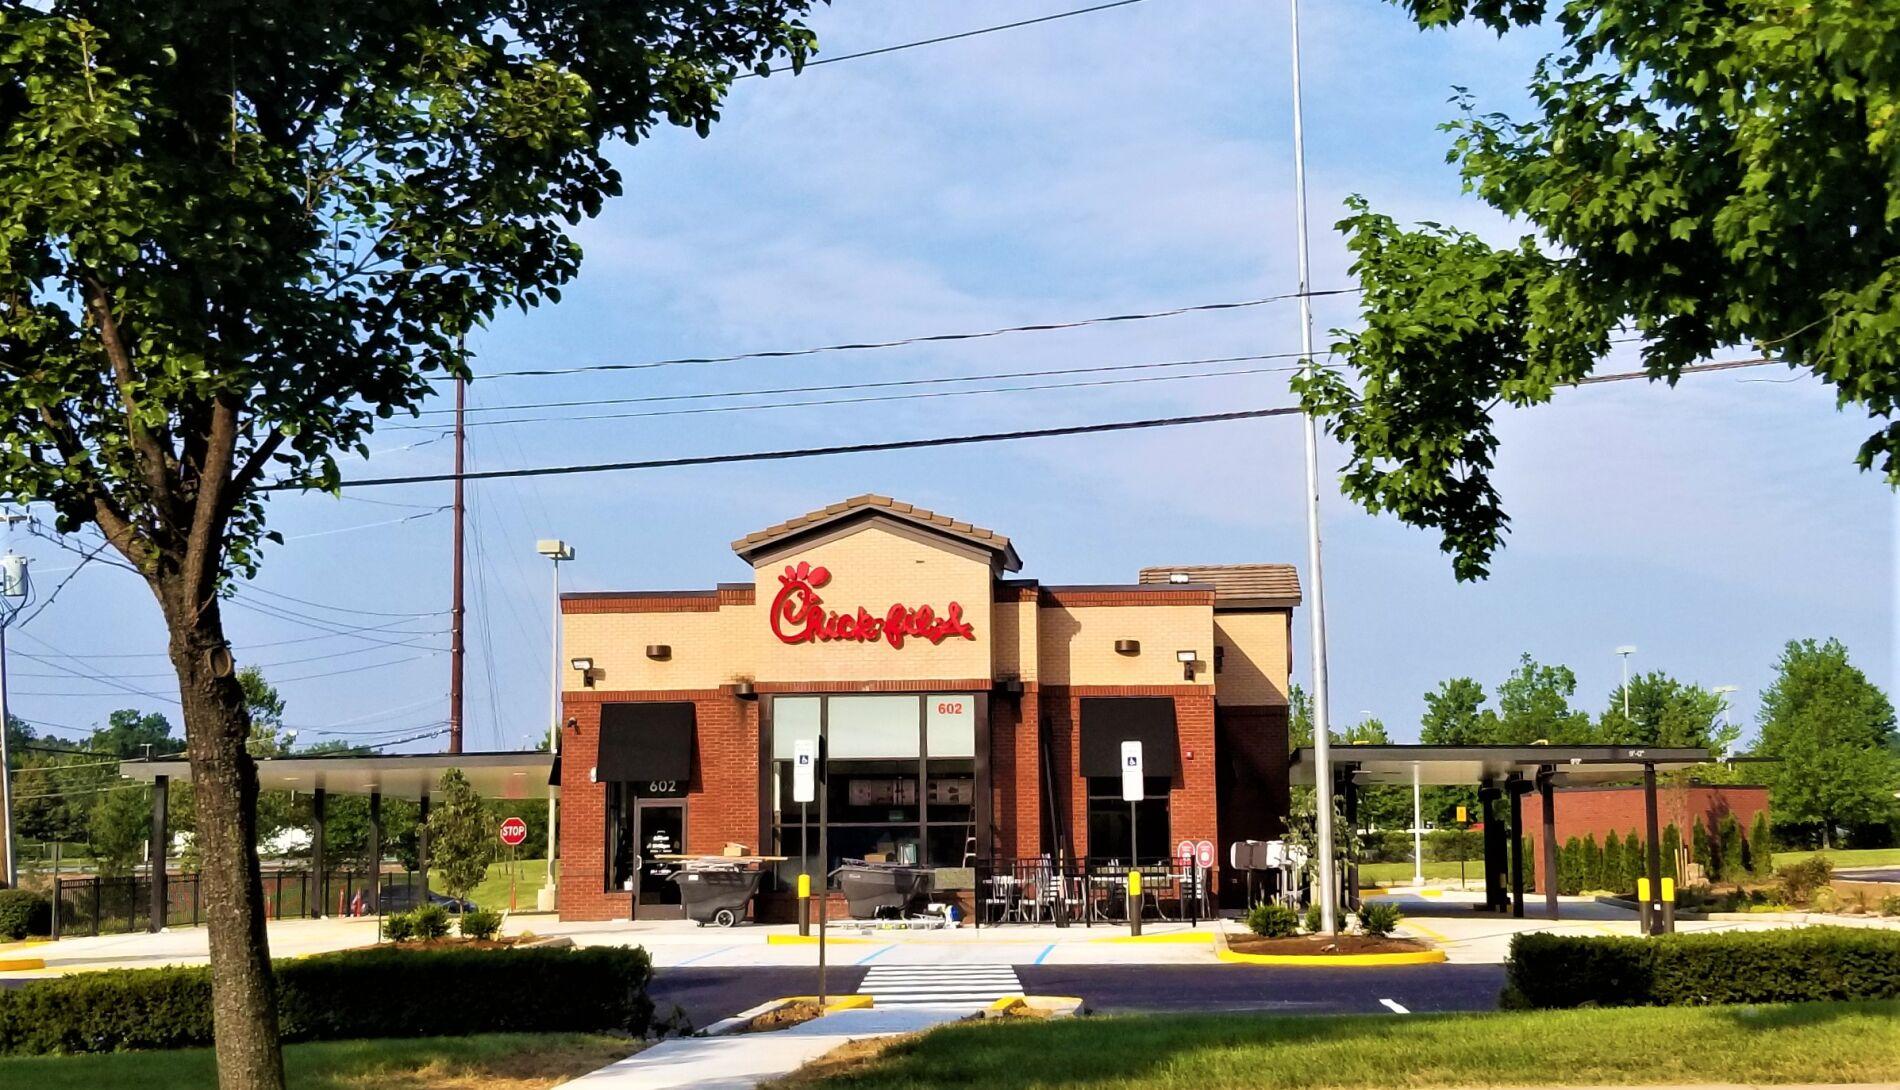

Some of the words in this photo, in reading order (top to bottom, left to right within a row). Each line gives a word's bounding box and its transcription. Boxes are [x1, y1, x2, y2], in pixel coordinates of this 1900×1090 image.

[938, 703, 962, 715] 602
[649, 780, 676, 792] 602
[502, 826, 525, 836] STOP
